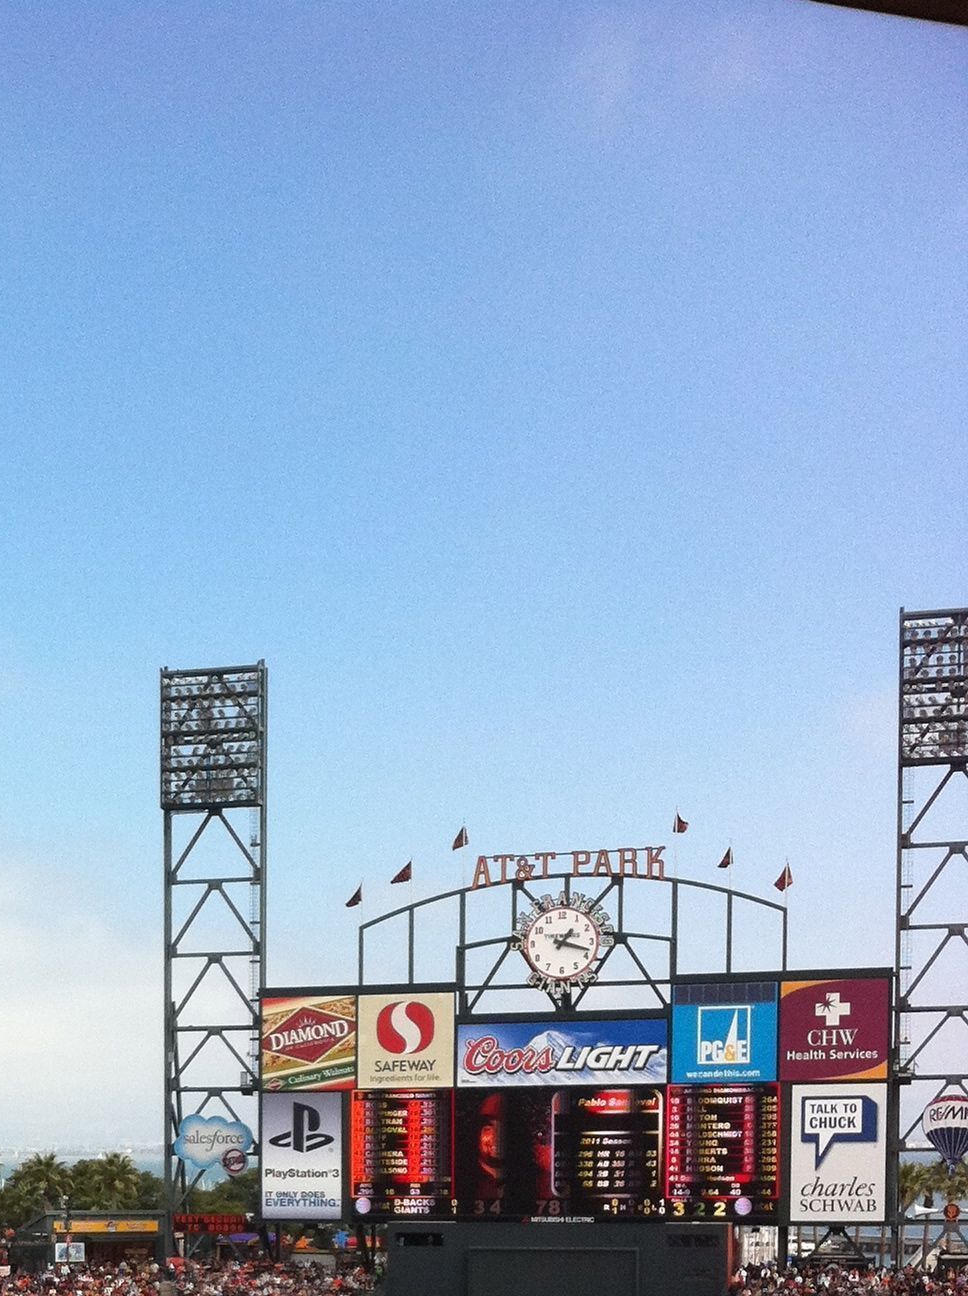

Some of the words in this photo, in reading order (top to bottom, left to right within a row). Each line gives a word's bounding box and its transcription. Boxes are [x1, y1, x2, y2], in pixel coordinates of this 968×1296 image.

[470, 851, 556, 891] AT&T
[571, 846, 666, 883] PARK
[526, 967, 599, 993] GIANTS
[270, 1020, 349, 1051] DIAMOND
[807, 1029, 859, 1046] CHW
[464, 1036, 554, 1075] Coors
[555, 1045, 660, 1072] LIGHT
[700, 1039, 748, 1063] PG&E
[787, 1050, 825, 1061] Health
[829, 1048, 878, 1060] Services
[375, 1060, 437, 1073] SAFEWAY
[370, 1075, 412, 1085] Ingredients
[414, 1075, 425, 1083] for
[810, 1104, 839, 1114] TALK
[843, 1103, 858, 1113] TO
[810, 1116, 857, 1128] CHUCK
[184, 1130, 244, 1152] salesforce
[800, 1176, 876, 1197] charles
[301, 1191, 325, 1199] DOES
[393, 1206, 430, 1214] GIANTS
[673, 1202, 685, 1216] 3
[694, 1202, 706, 1216] 2
[714, 1202, 726, 1216] 2
[800, 1199, 877, 1212] SCHWAB
